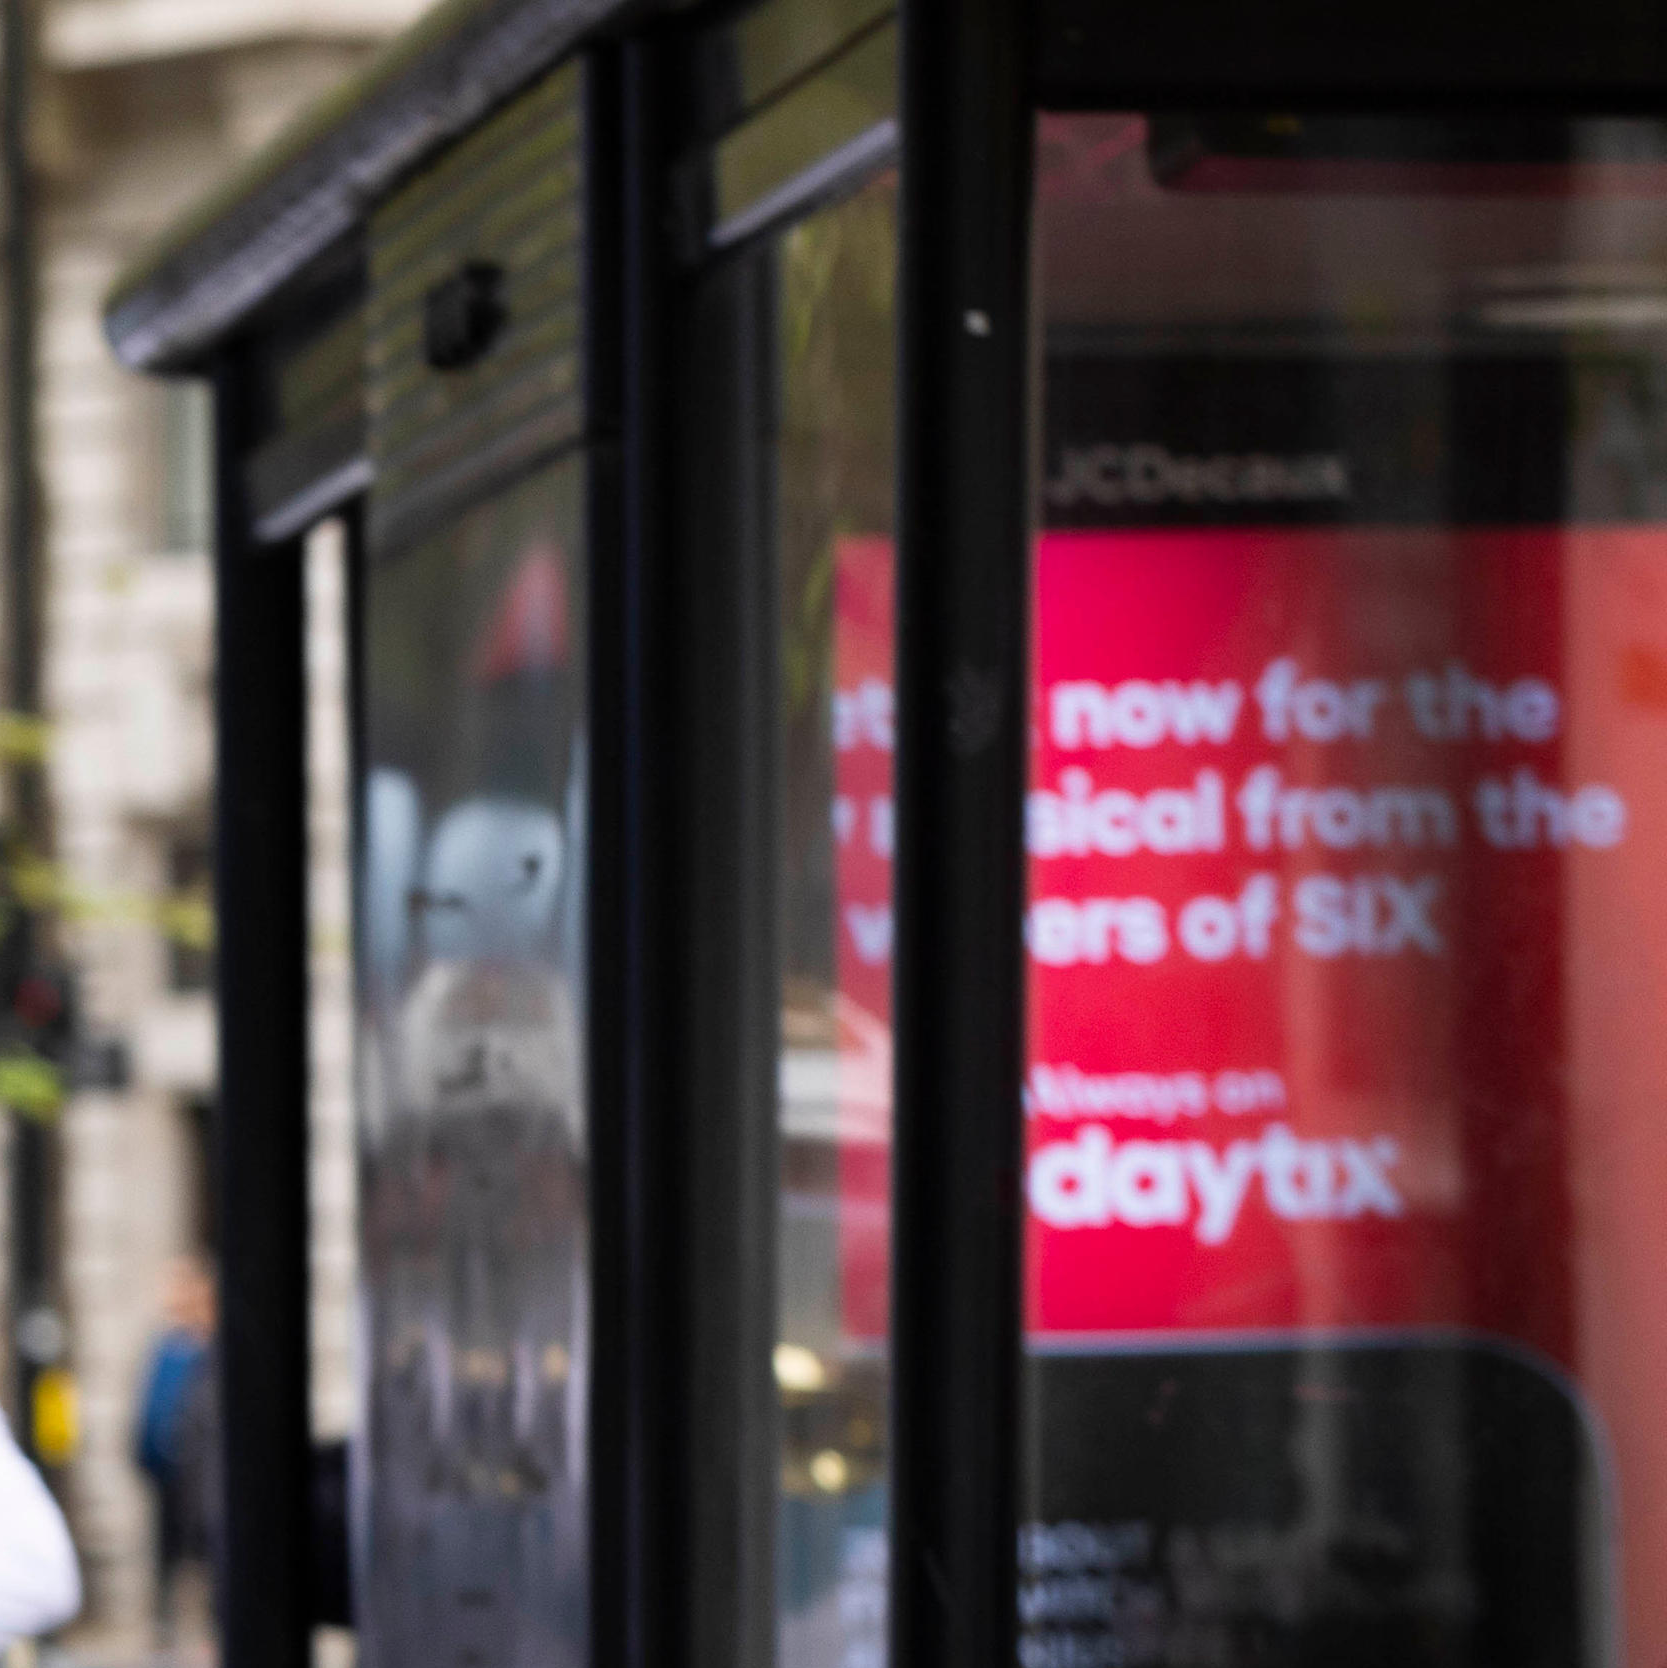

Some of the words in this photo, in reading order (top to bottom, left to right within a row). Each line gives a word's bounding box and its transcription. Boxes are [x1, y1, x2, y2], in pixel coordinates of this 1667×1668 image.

[1049, 677, 1243, 744] now
[1255, 655, 1381, 744] for
[1406, 659, 1560, 743] the
[1238, 764, 1461, 851] from
[1479, 769, 1627, 849] the
[1178, 871, 1280, 962] of
[1295, 873, 1444, 959] SIX
[1024, 1066, 1206, 1126] Always
[1214, 1069, 1285, 1113] on
[1027, 1122, 1403, 1247] daytix
